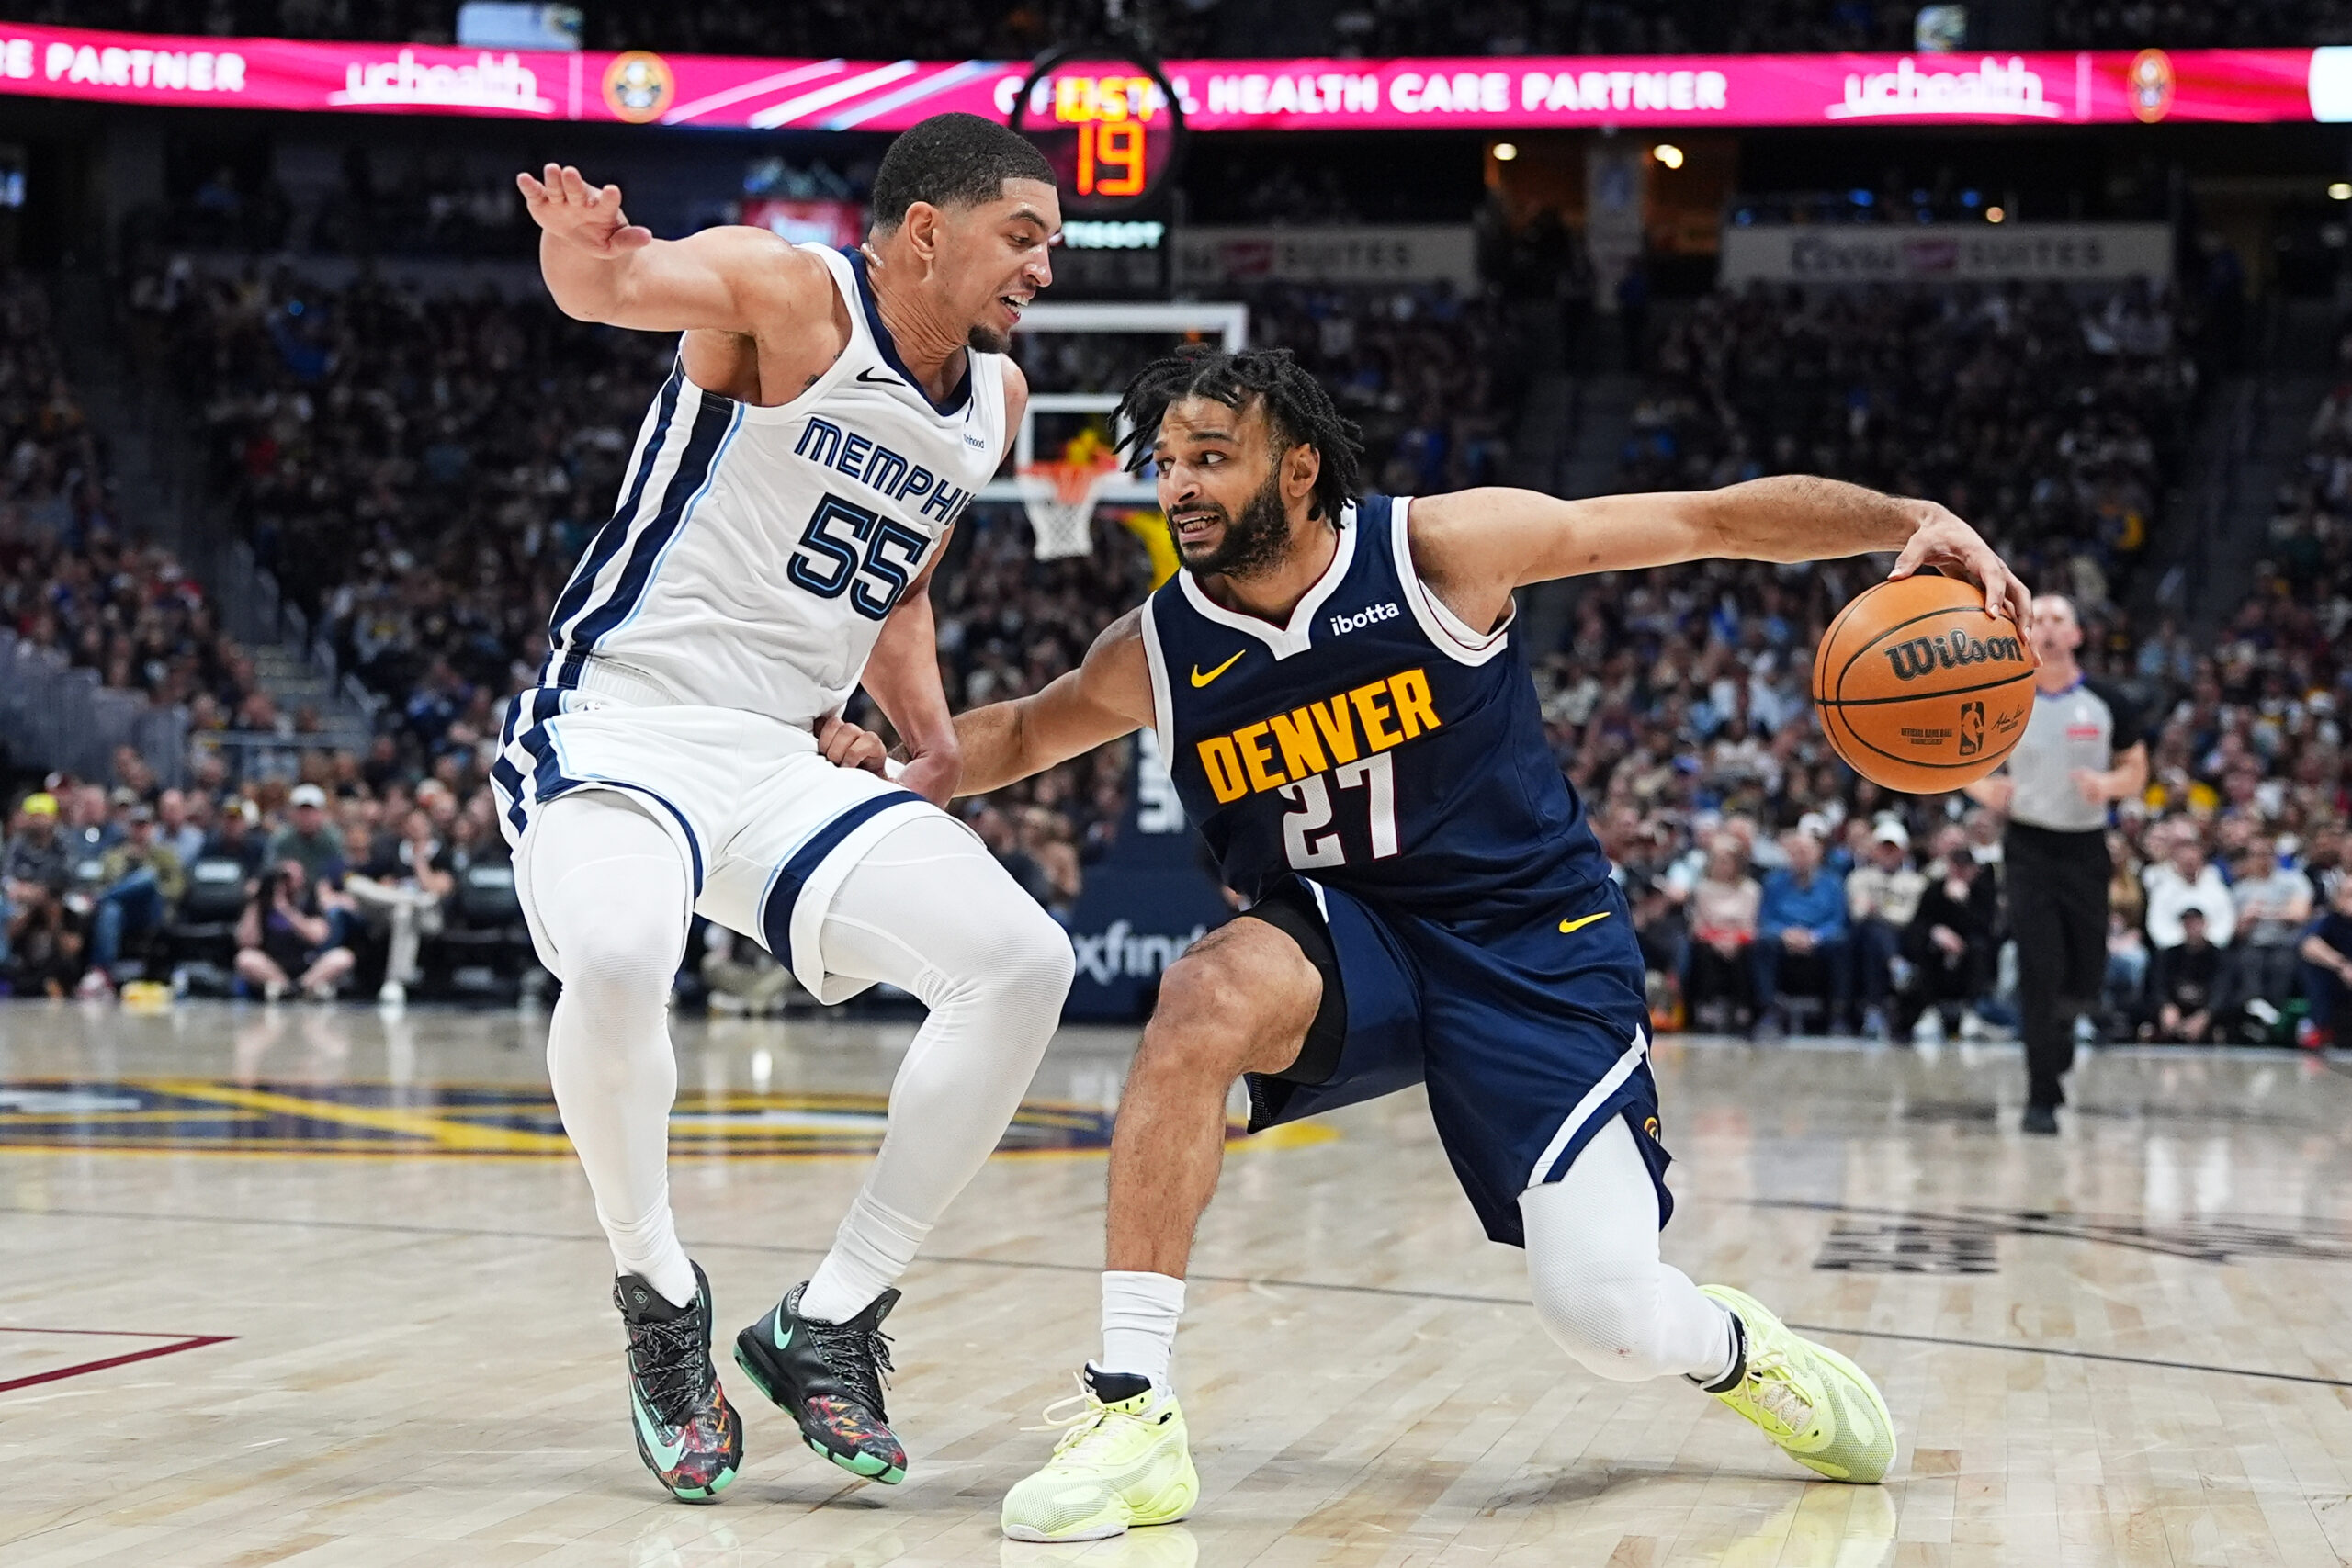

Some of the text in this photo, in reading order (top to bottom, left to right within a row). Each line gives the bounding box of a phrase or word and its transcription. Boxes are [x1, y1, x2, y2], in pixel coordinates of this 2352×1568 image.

[45, 42, 246, 92] PARTNER
[346, 49, 537, 104] uchealth
[1208, 74, 1379, 114] HEALTH
[1389, 73, 1510, 112] CARE
[1521, 72, 1728, 112] PARTNER
[1845, 56, 2044, 113] uchealth
[1077, 120, 1147, 197] 19
[786, 491, 932, 622] 55
[1330, 602, 1400, 637] ibotta
[1883, 628, 2025, 682] Wilson
[1196, 667, 1443, 805] DENVER
[1277, 750, 1399, 870] 27
